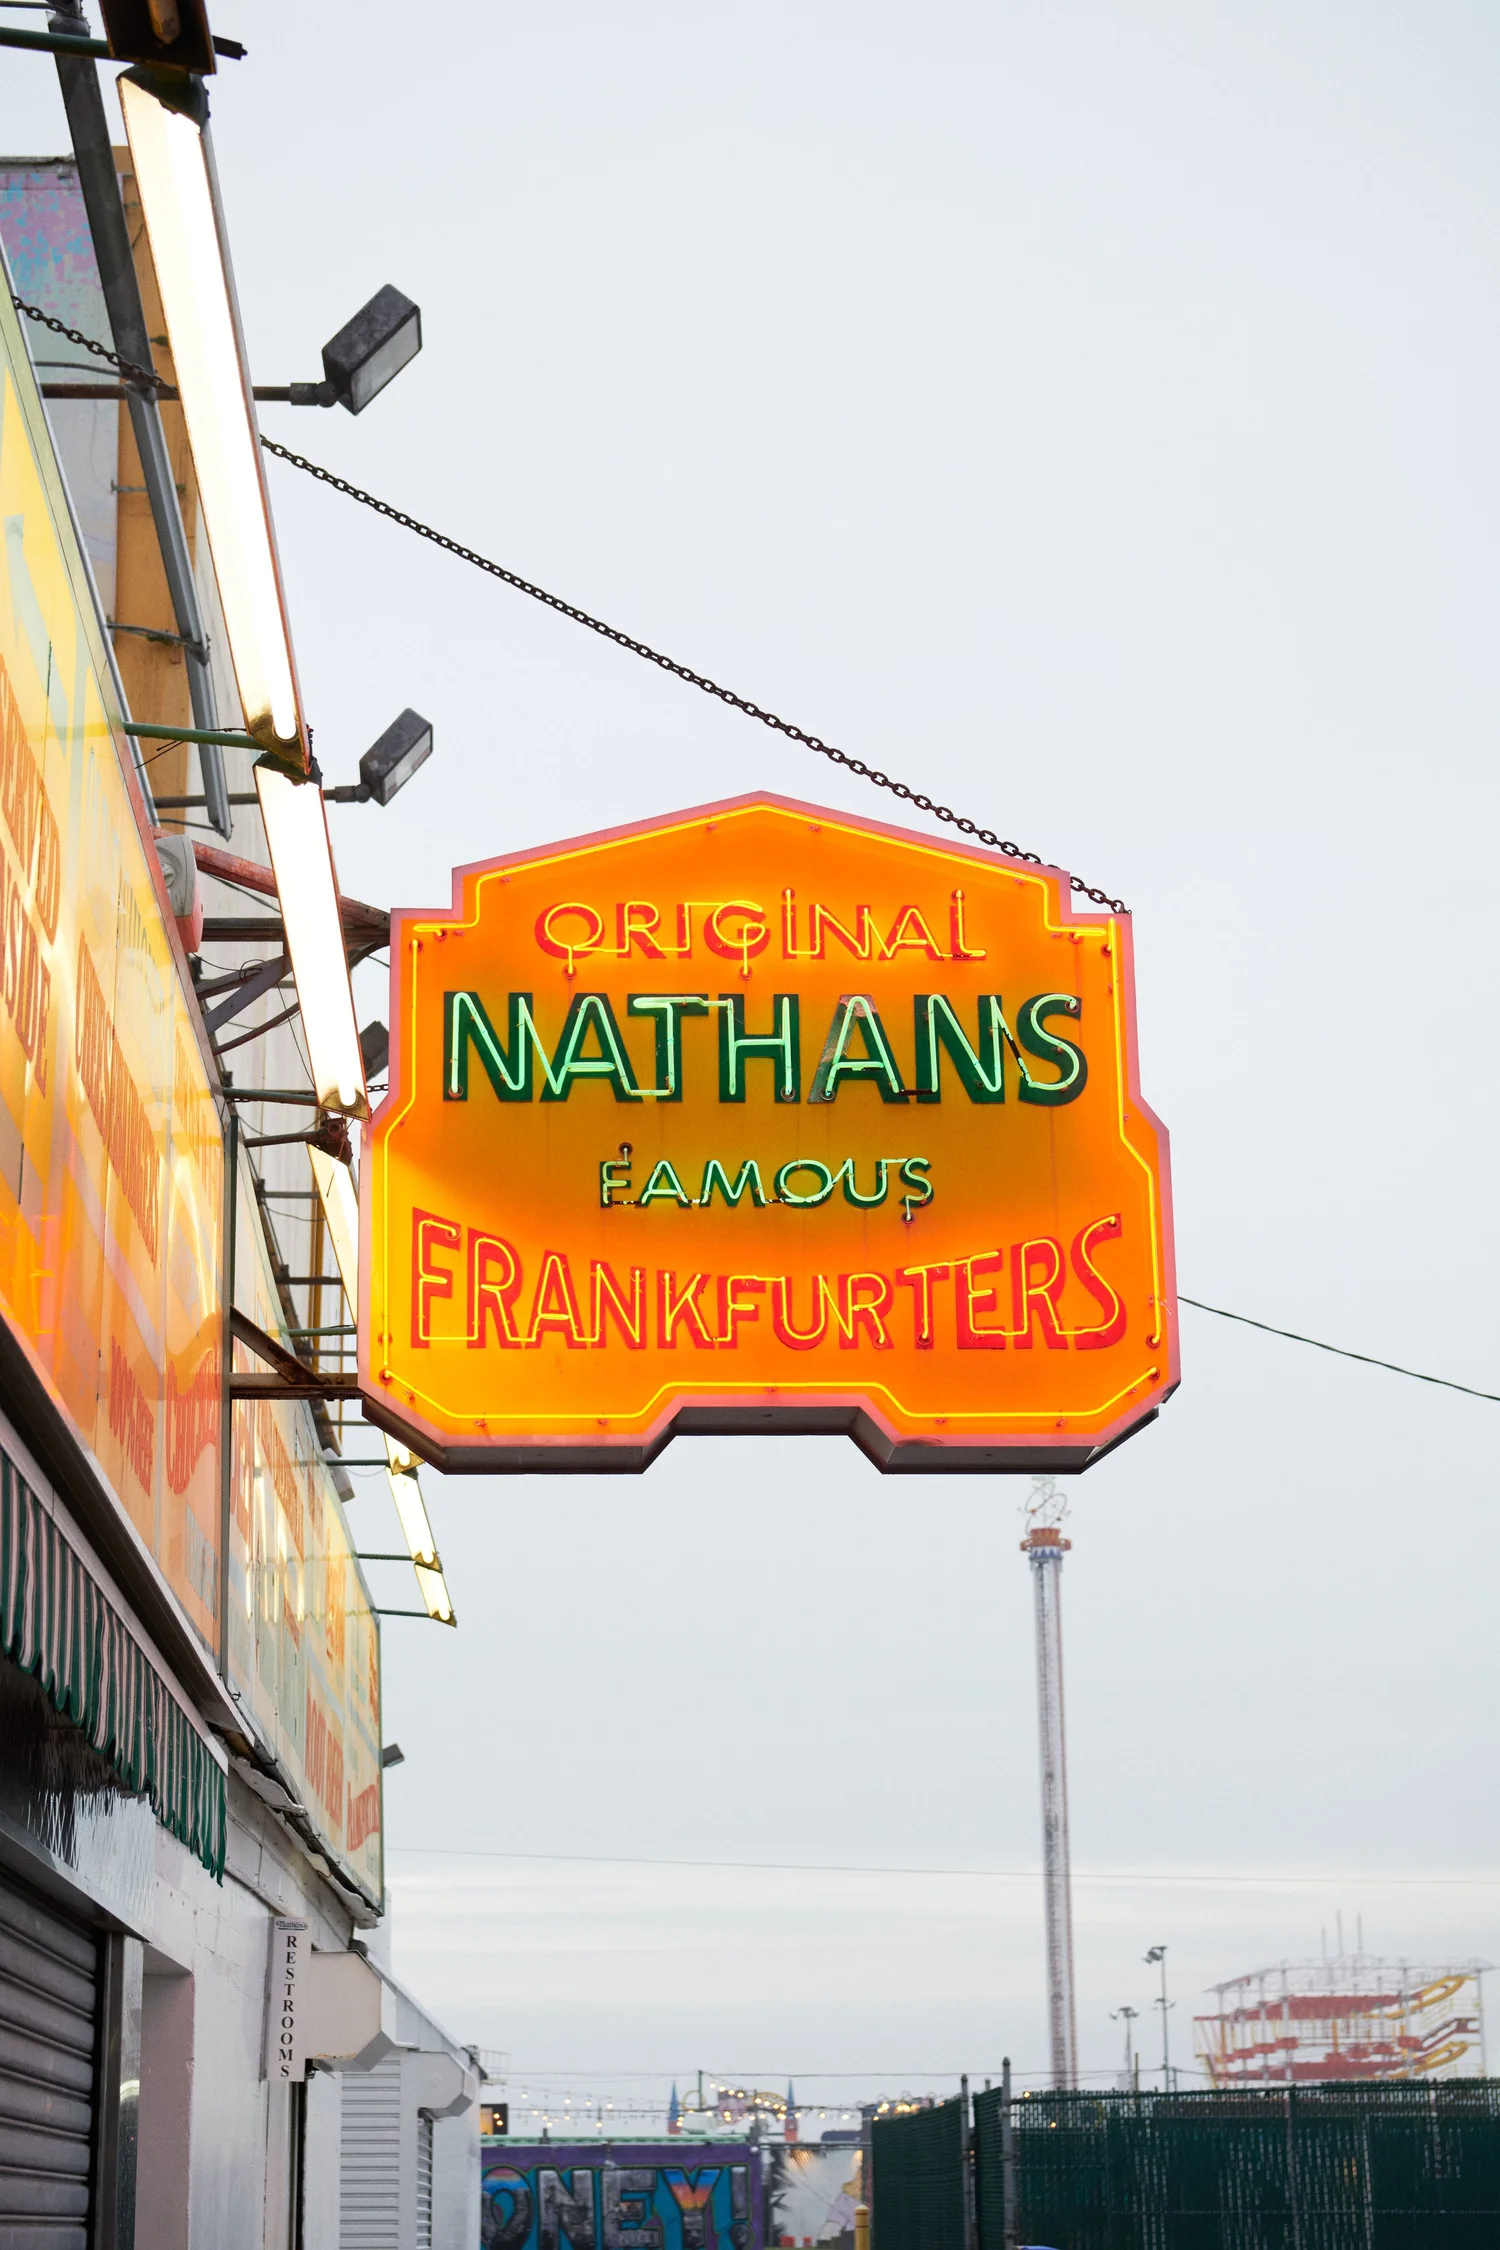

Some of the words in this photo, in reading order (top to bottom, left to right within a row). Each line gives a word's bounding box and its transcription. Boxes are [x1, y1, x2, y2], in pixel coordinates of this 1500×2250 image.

[534, 900, 987, 961] ORIGINAL
[442, 990, 1089, 1106] NATHANS
[600, 1156, 935, 1209] FAMOUS
[410, 1207, 1128, 1352] FRANKFURTERS
[278, 1935, 298, 2078] RESTROOMS
